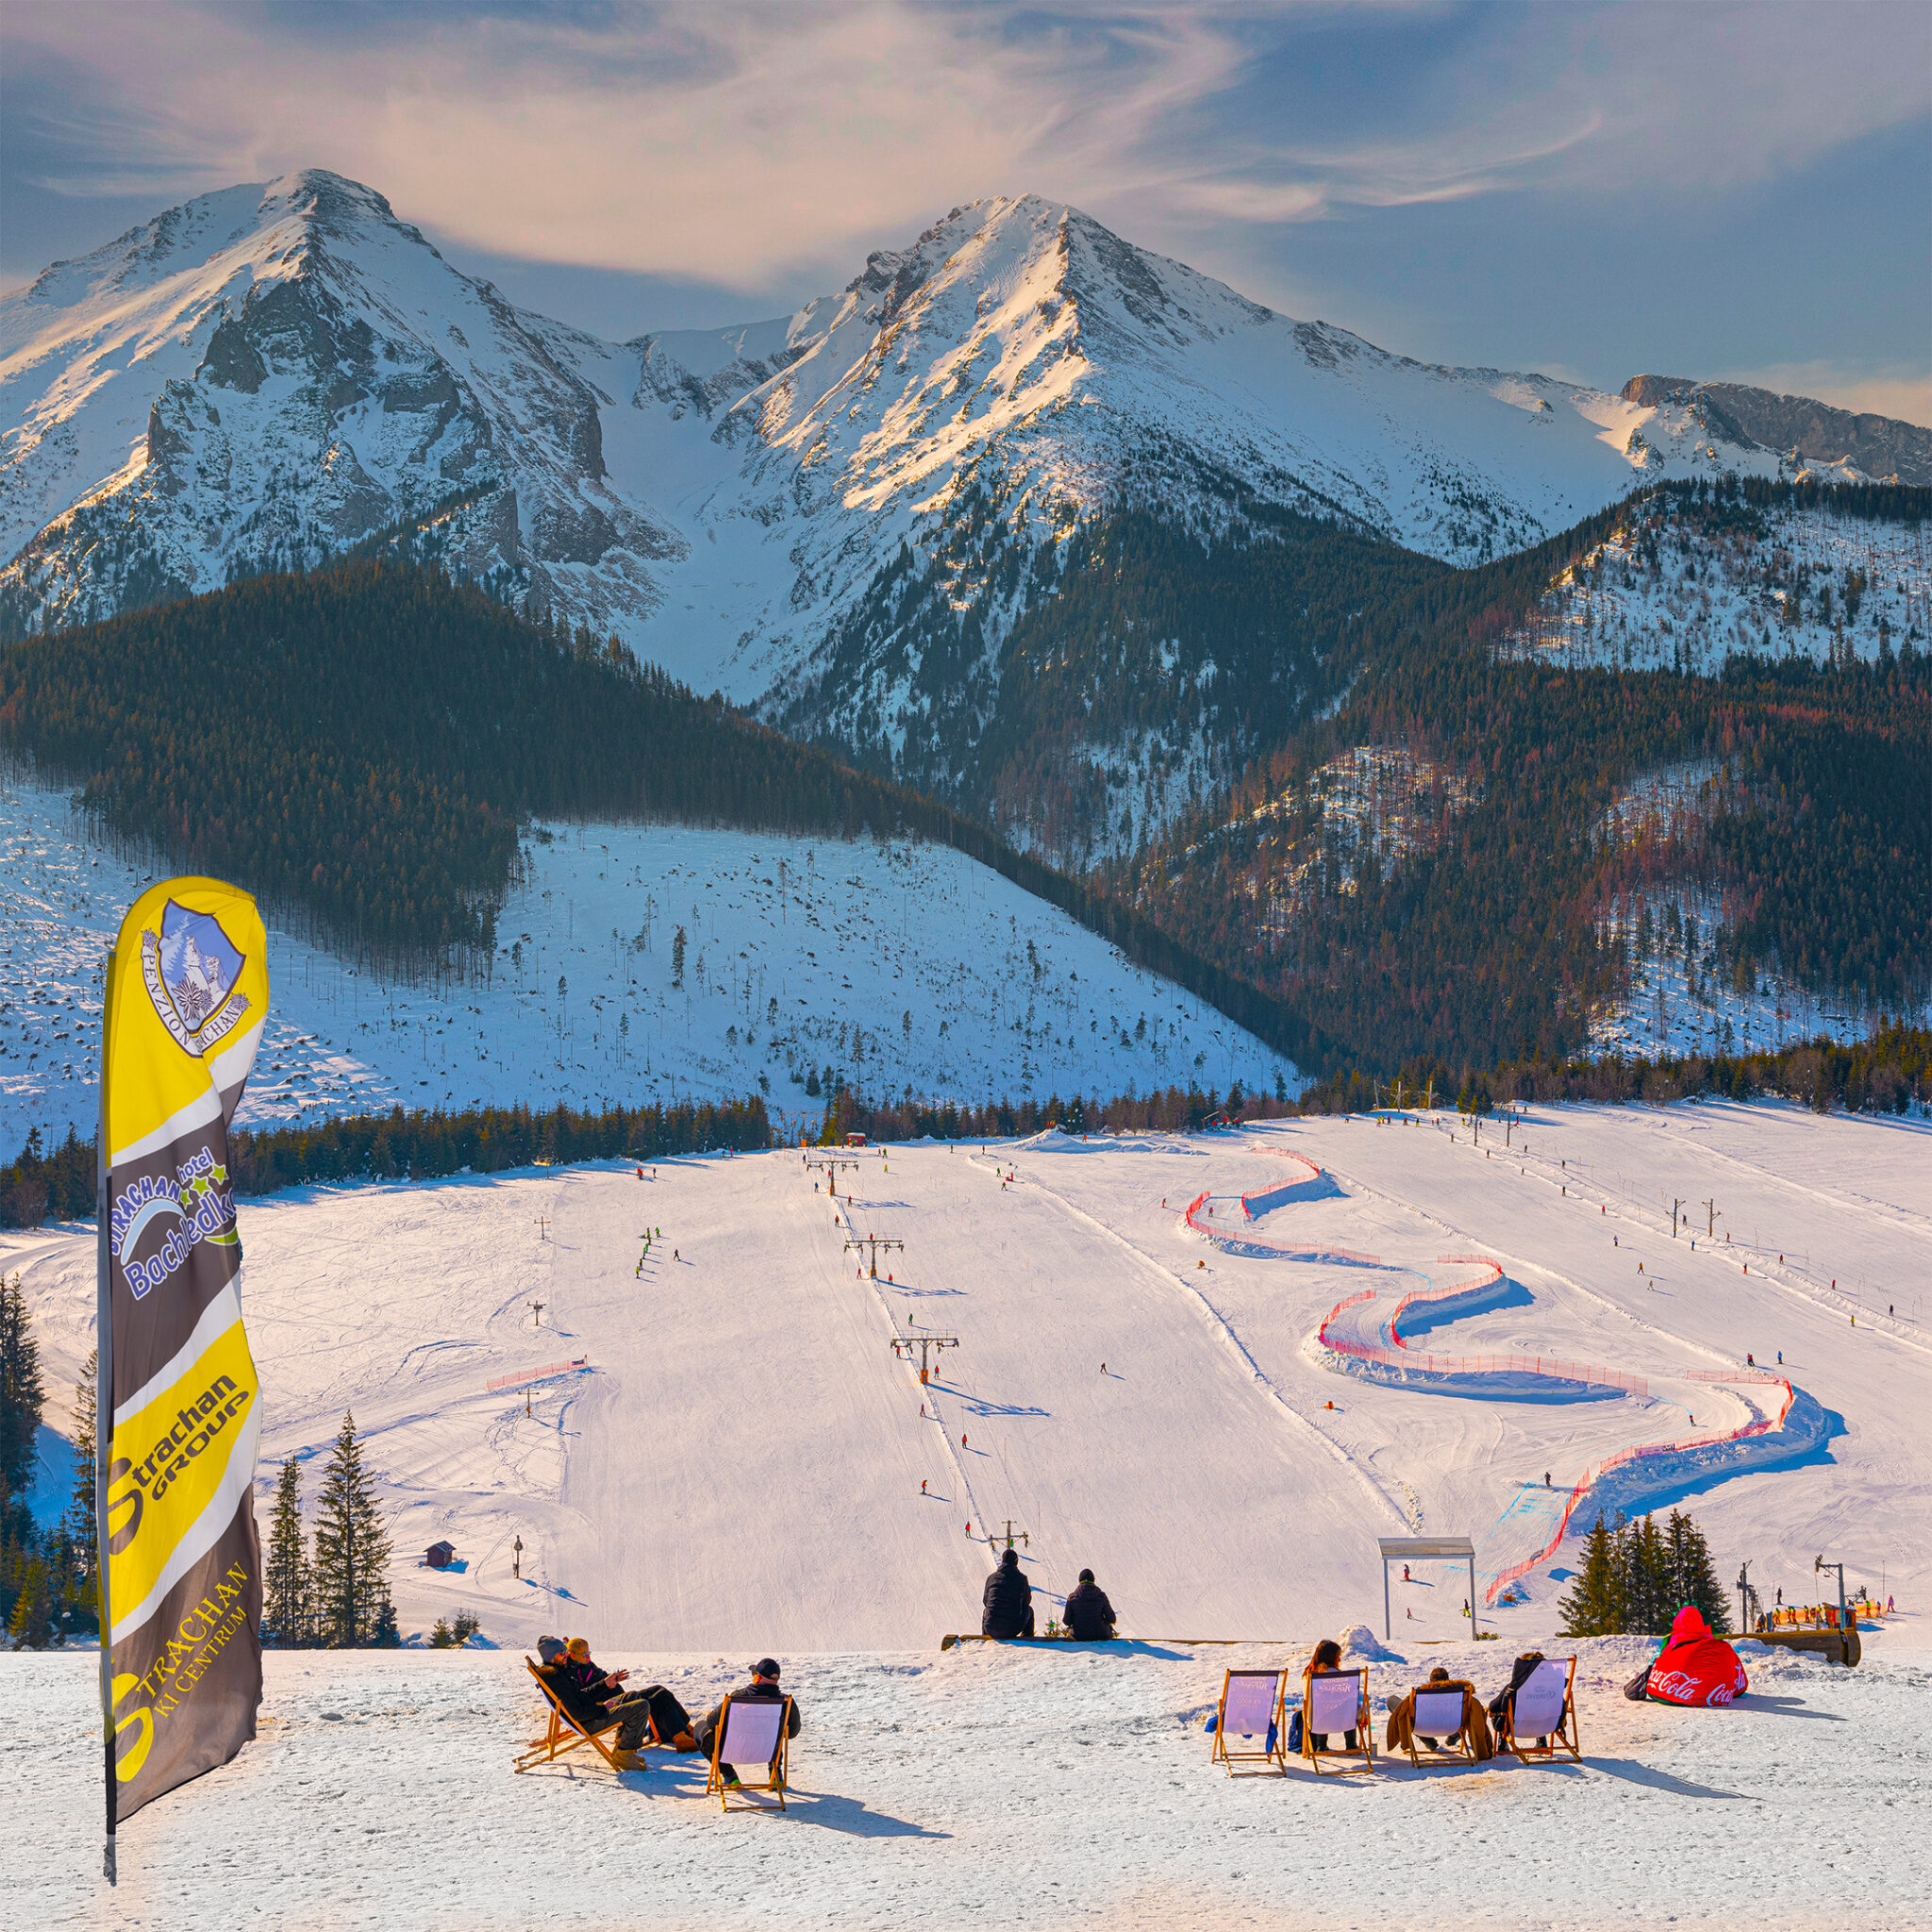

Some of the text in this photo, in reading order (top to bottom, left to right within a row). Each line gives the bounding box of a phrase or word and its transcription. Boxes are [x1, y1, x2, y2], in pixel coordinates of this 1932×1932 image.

[143, 954, 192, 1046] PENZION
[176, 1146, 215, 1185] hotel
[152, 1391, 249, 1501] GROUP
[175, 1606, 247, 1692] CENTRUM
[1647, 1663, 1703, 1700] ca-Cola
